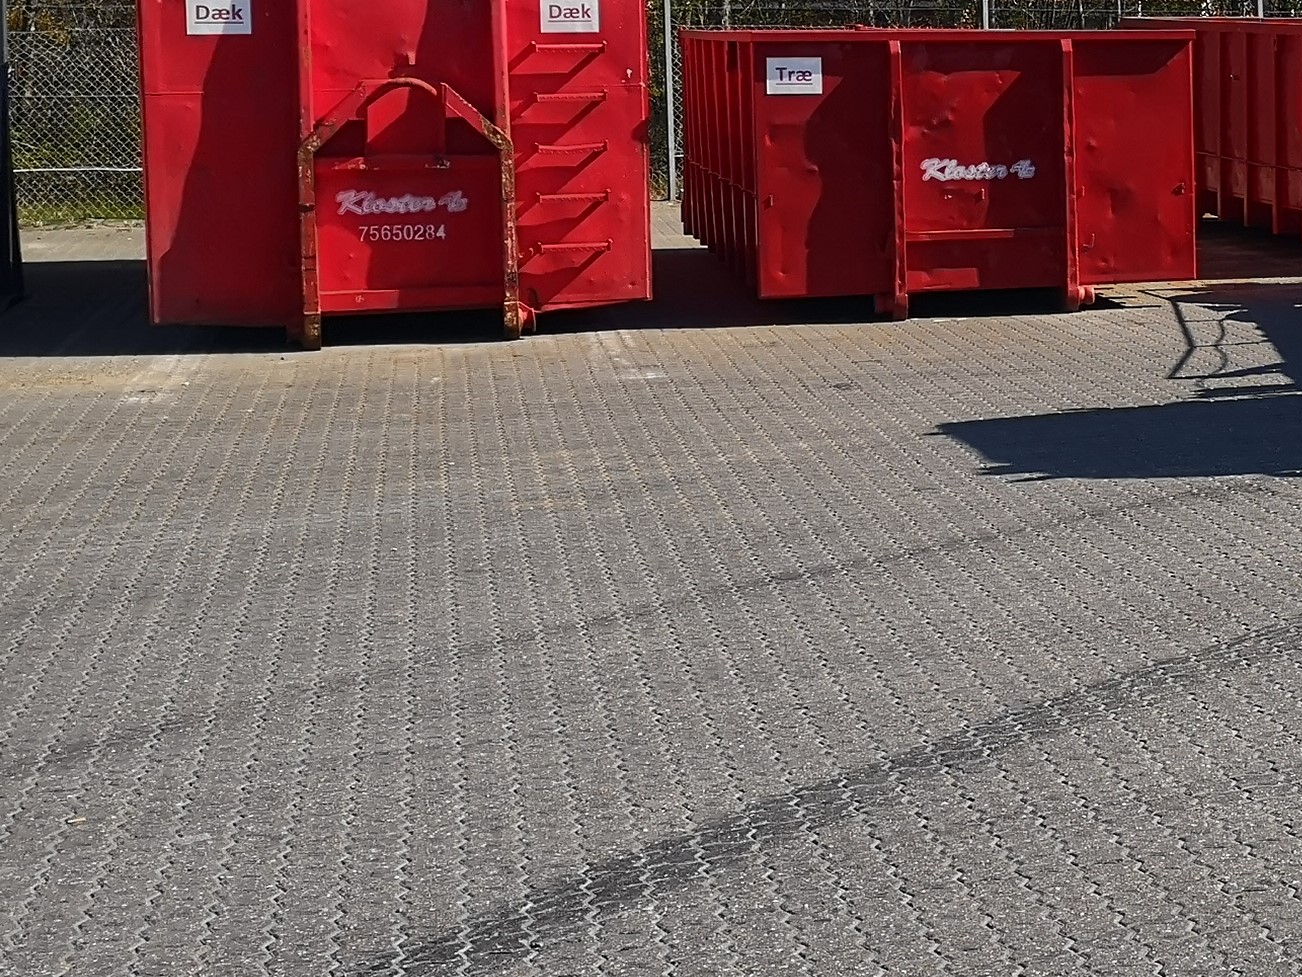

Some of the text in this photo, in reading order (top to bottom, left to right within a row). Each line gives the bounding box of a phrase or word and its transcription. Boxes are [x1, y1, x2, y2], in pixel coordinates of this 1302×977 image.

[195, 4, 243, 20] Dæk
[548, 3, 592, 19] Dæk
[775, 67, 812, 82] Træ
[920, 158, 1008, 181] Kloster
[335, 189, 436, 215] Kloster
[358, 224, 446, 242] 75650284
